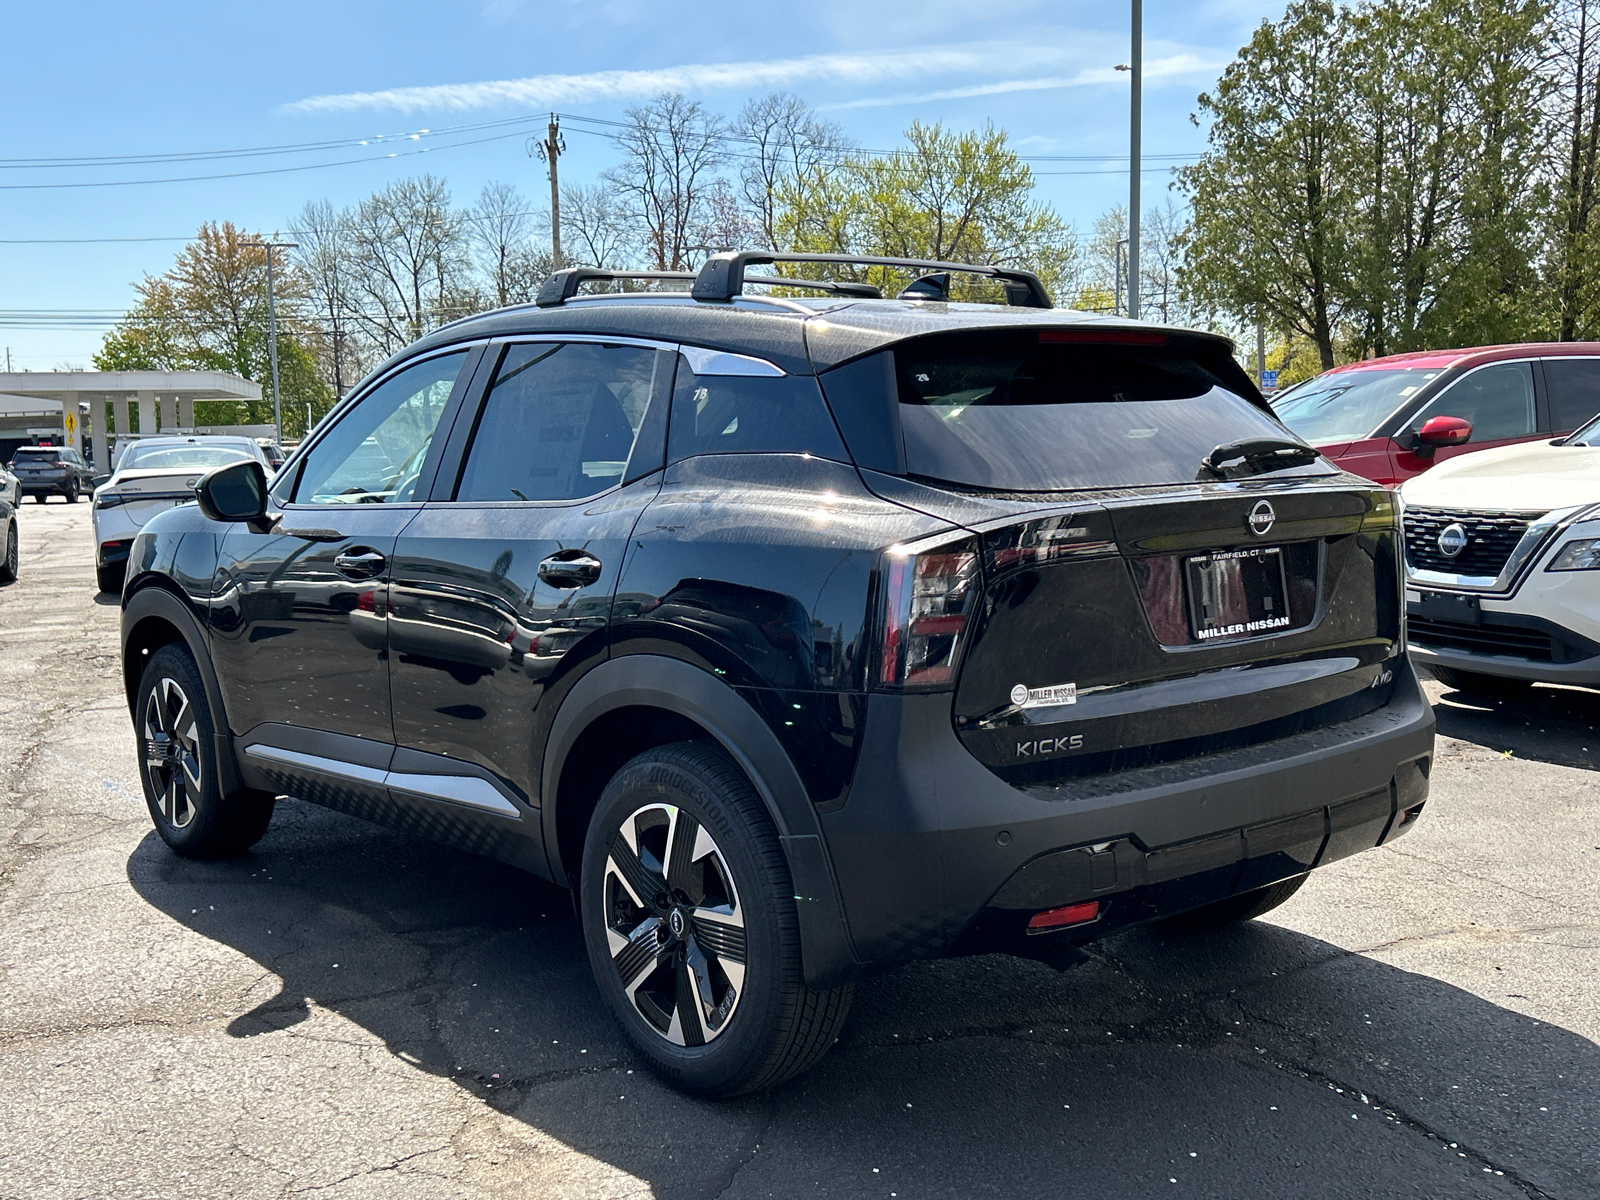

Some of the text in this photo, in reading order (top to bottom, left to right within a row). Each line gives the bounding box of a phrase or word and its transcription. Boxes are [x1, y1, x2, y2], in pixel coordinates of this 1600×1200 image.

[1249, 513, 1276, 524] NISSAN
[1250, 549, 1260, 557] CT
[1198, 616, 1290, 639] MILLER NISSAN
[1029, 686, 1076, 701] MILLER NISSAN
[1016, 734, 1083, 757] KICKS
[650, 765, 736, 840] BRIDGESTONE
